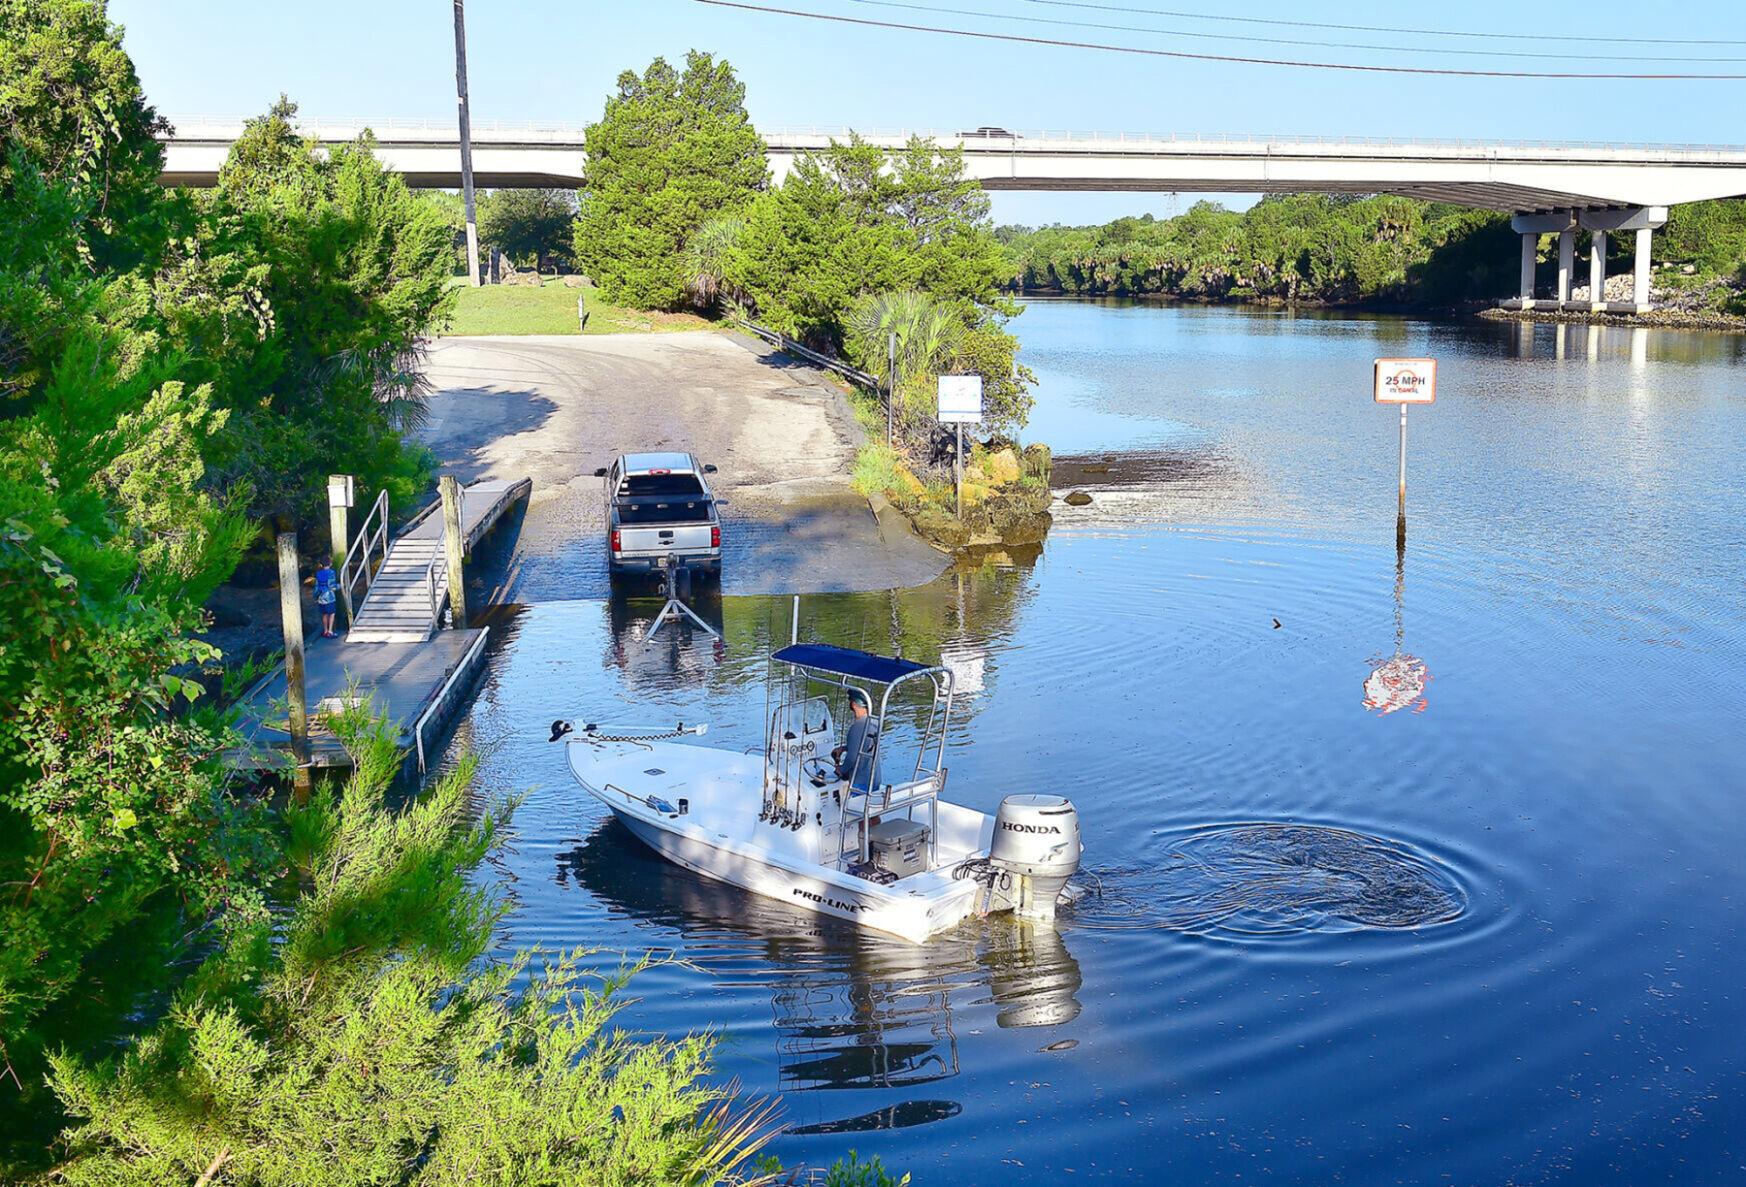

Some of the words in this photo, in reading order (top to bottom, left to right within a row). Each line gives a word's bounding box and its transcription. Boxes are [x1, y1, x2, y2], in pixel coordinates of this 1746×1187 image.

[1385, 376, 1399, 386] 25
[1402, 376, 1425, 386] MPH
[1002, 821, 1061, 834] HONDA
[793, 888, 858, 913] PRO-LINE
